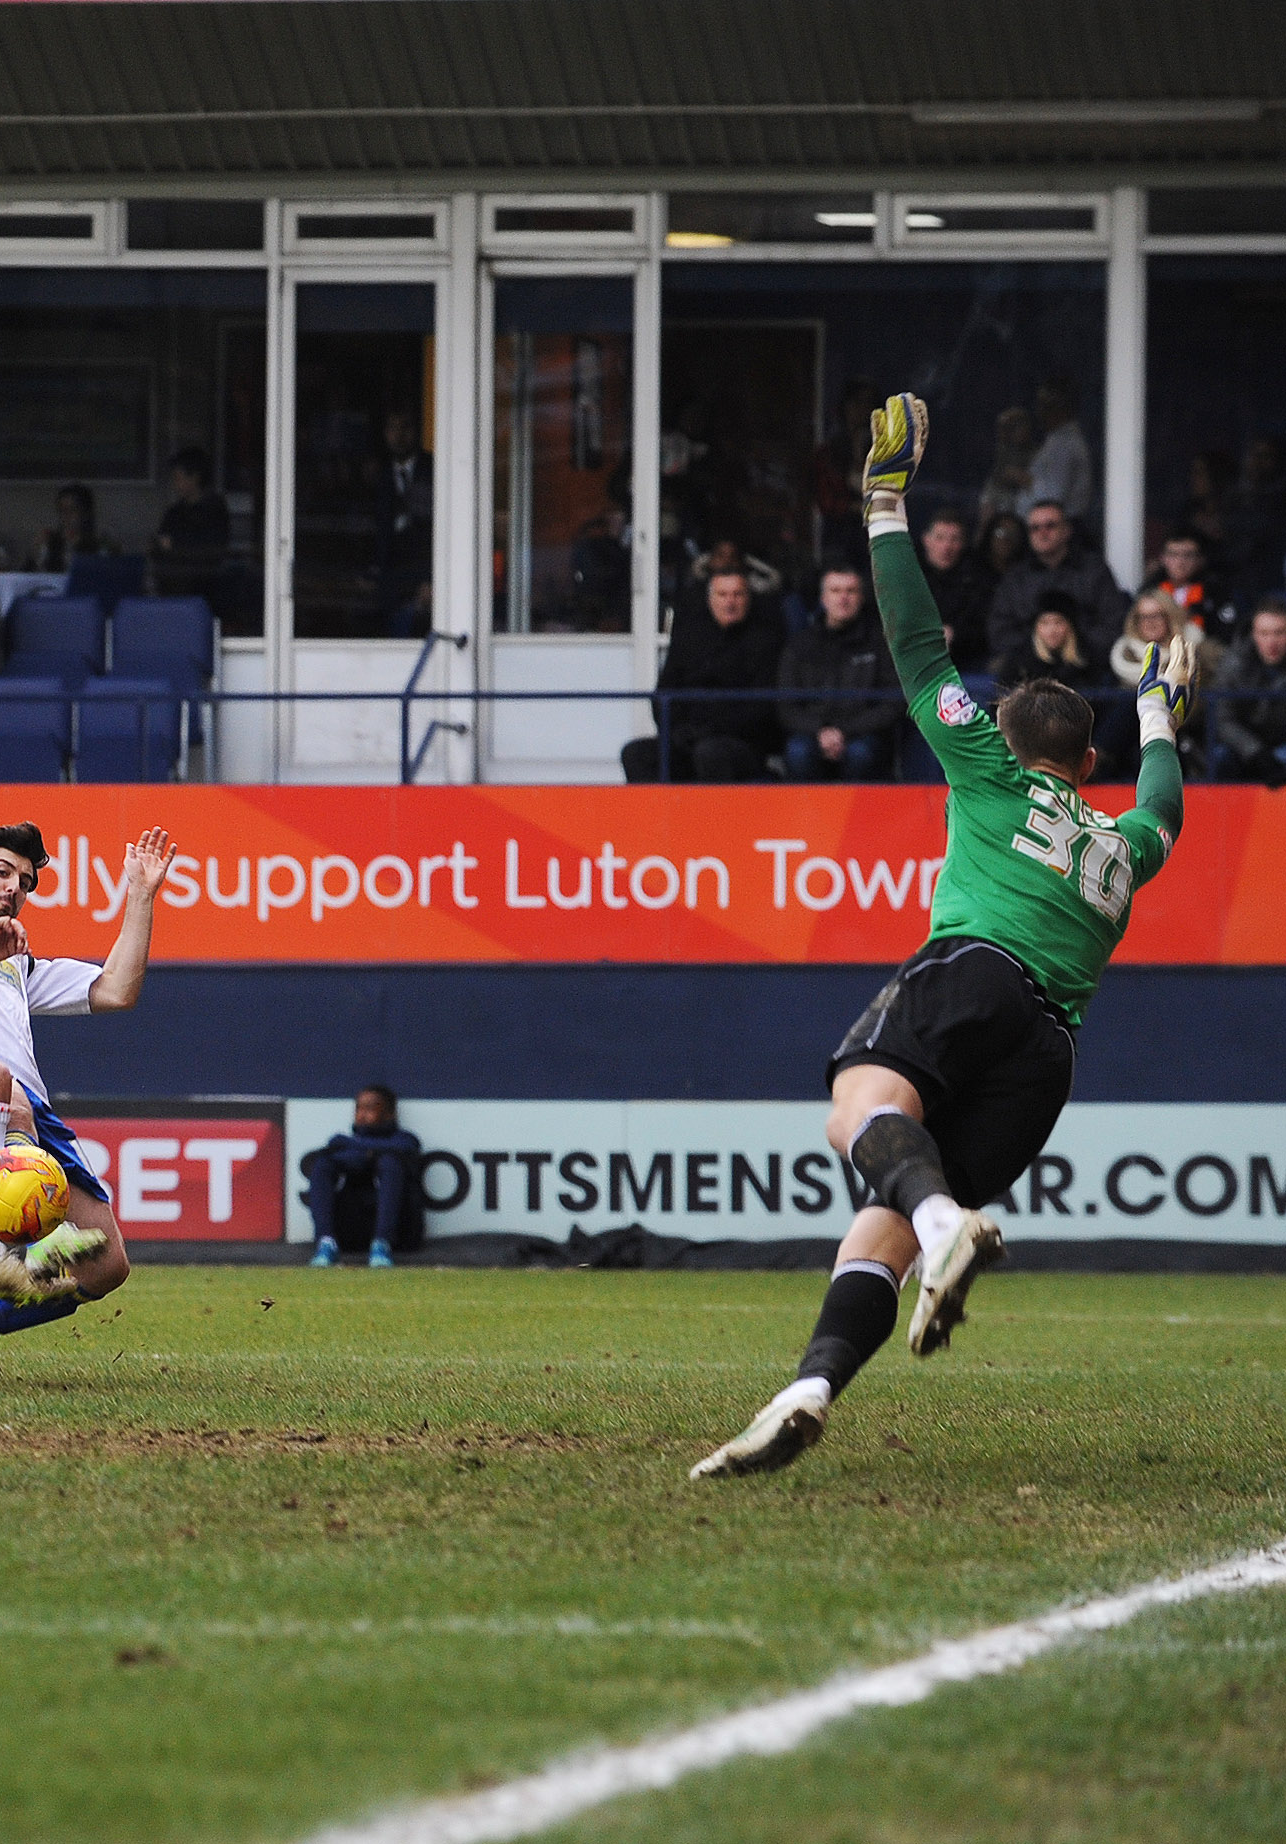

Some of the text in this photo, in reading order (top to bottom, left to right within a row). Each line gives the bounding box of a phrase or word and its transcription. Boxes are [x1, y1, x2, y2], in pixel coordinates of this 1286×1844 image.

[161, 840, 480, 922] support
[505, 838, 730, 910] Luton
[1012, 784, 1134, 924] 30
